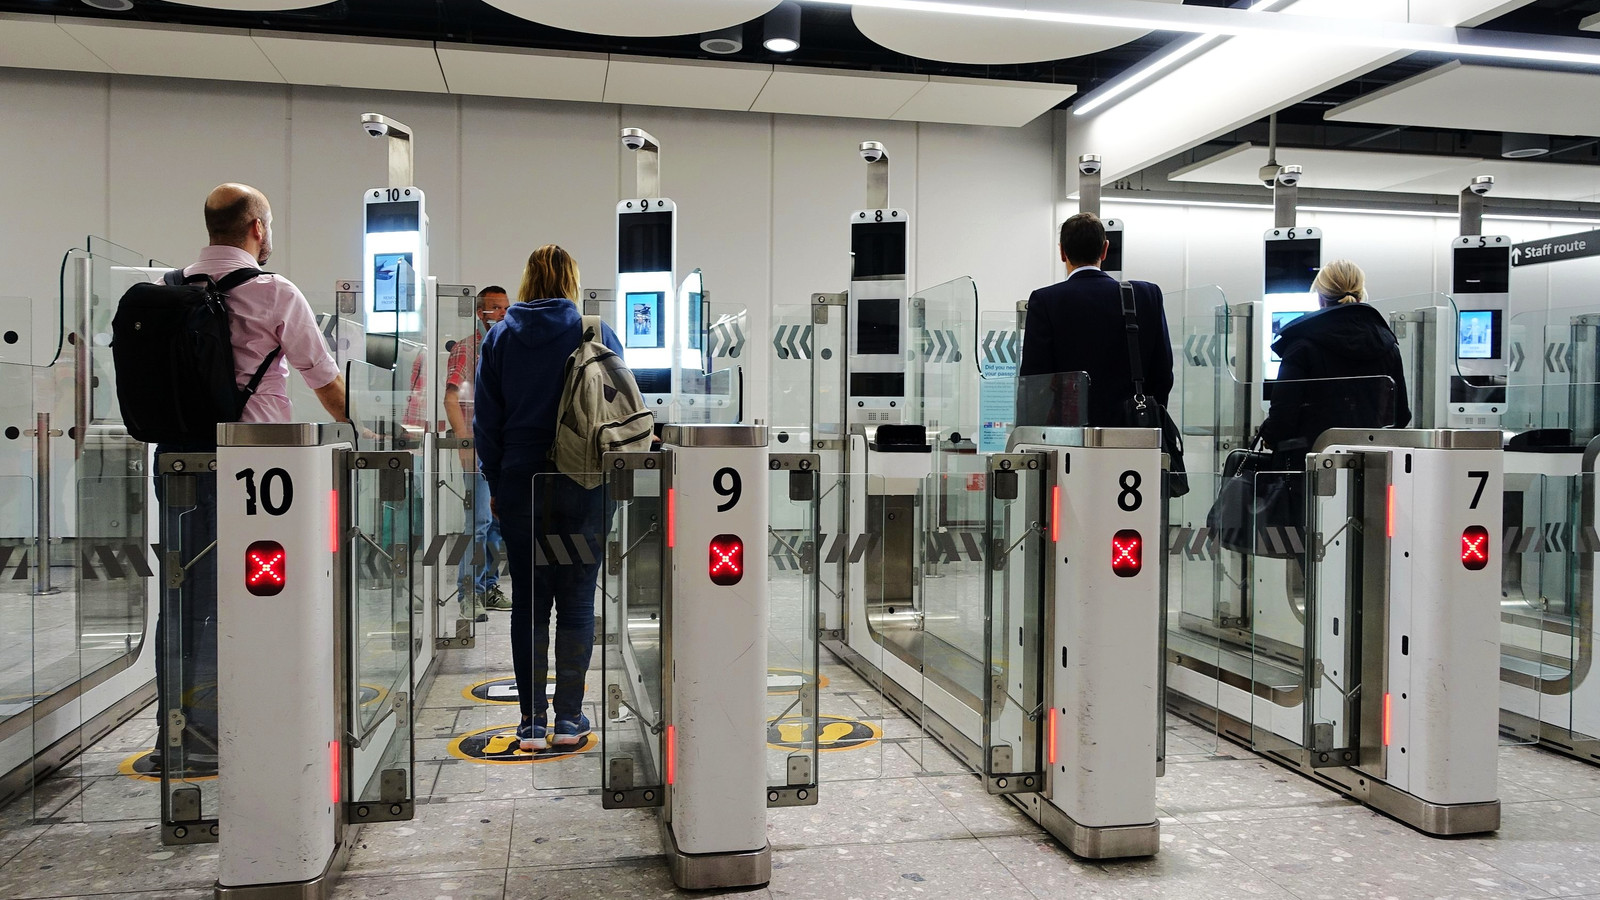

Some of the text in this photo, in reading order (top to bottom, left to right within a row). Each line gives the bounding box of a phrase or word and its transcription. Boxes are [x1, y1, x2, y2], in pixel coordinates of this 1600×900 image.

[385, 188, 400, 202] 10
[640, 199, 649, 212] 9
[875, 209, 883, 222] 8
[1287, 227, 1296, 240] 6
[1478, 236, 1487, 248] 5
[1524, 240, 1587, 259] Staff route
[235, 467, 294, 516] 10
[712, 466, 742, 513] 9
[1117, 469, 1143, 512] 8
[1467, 470, 1489, 510] 7
